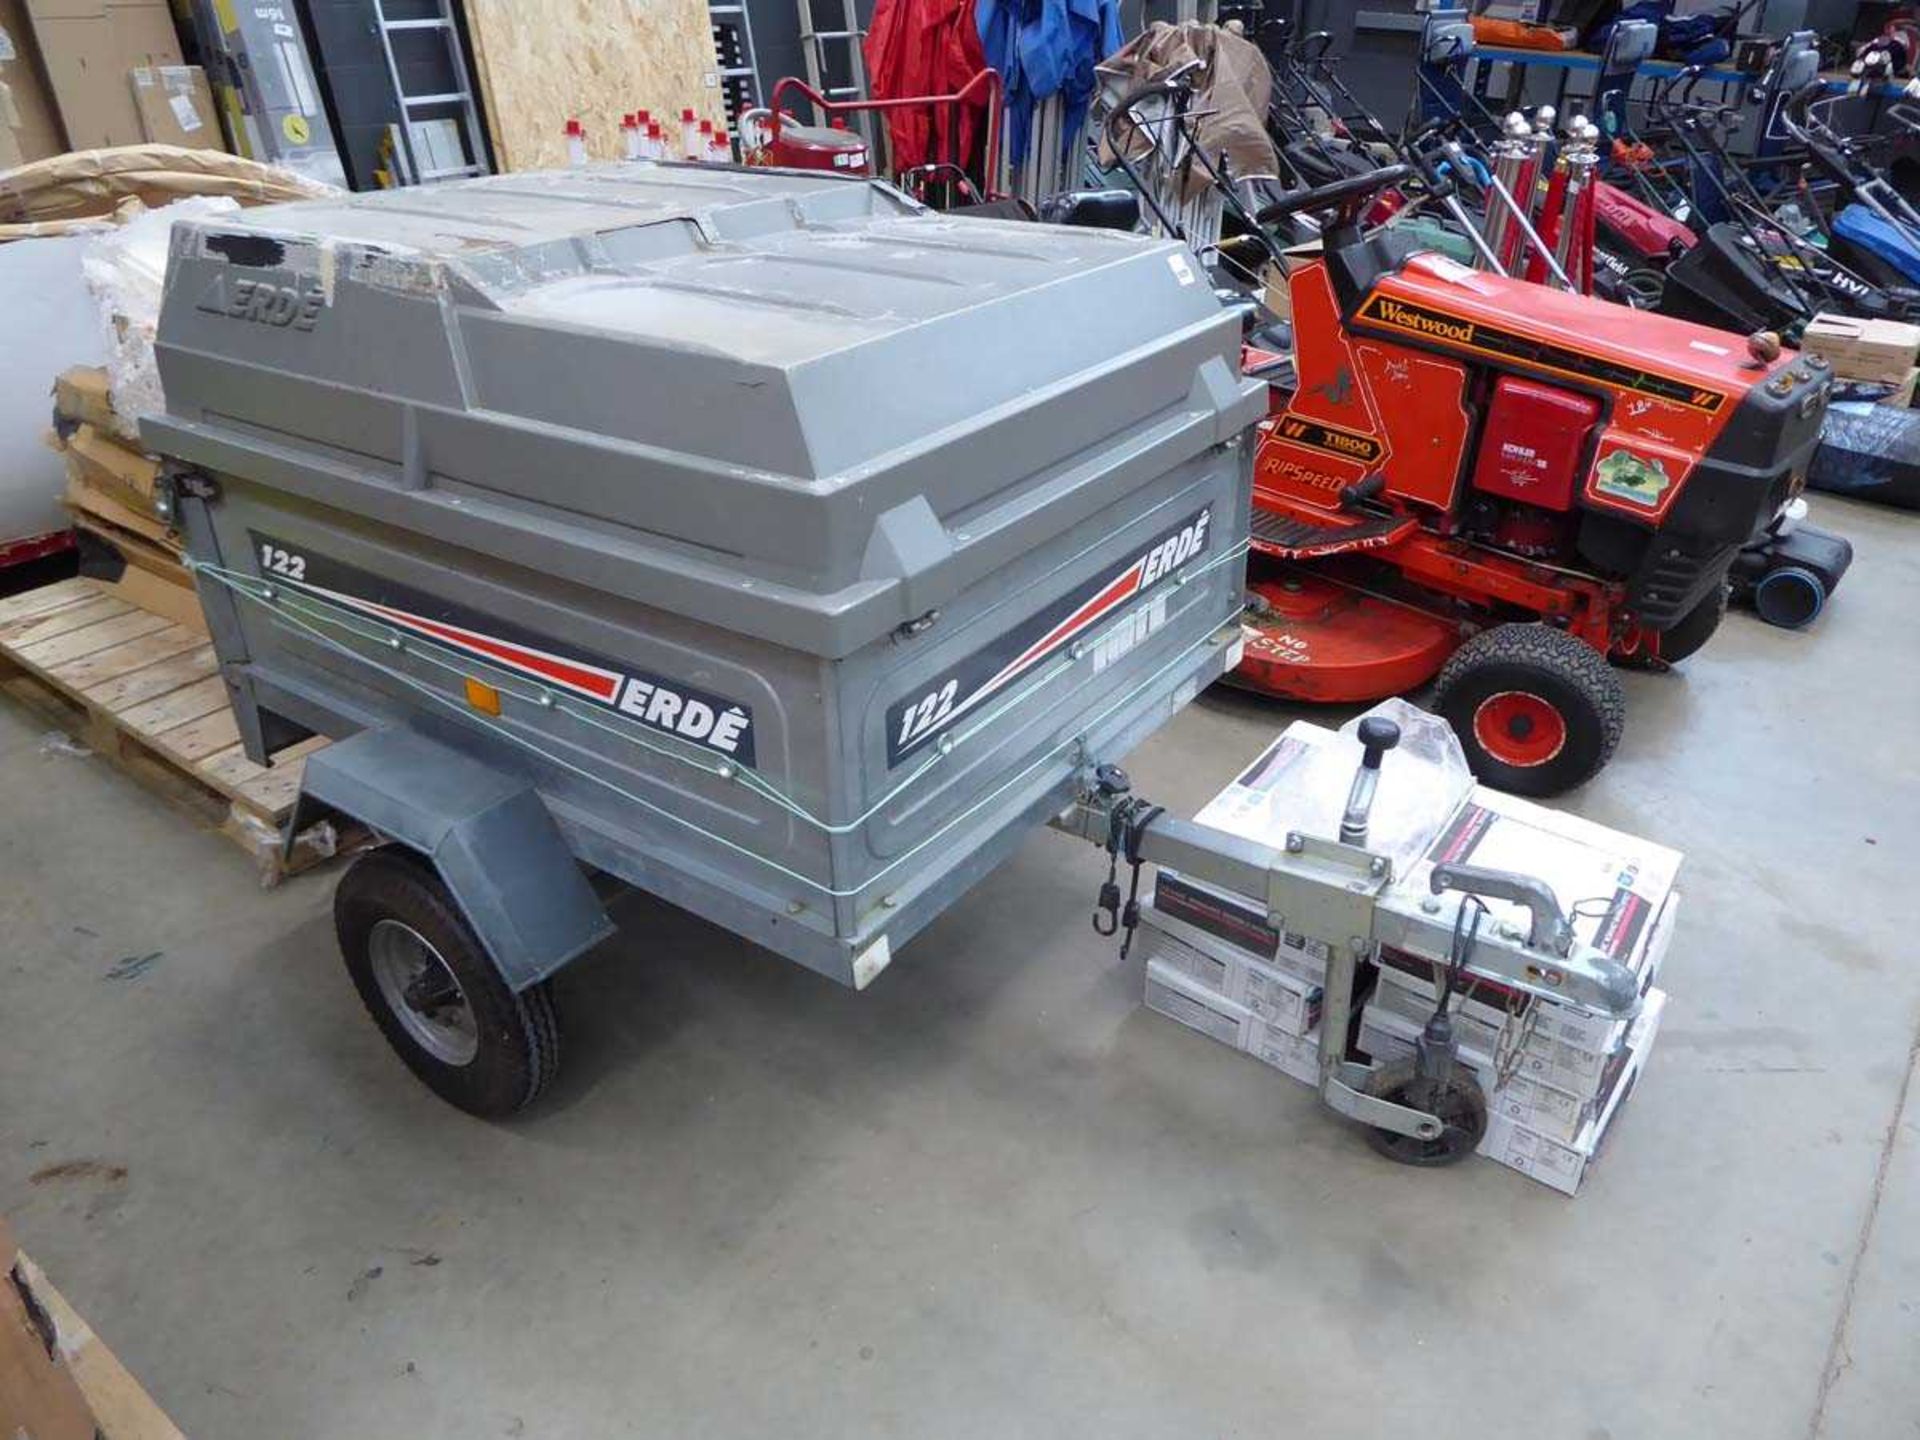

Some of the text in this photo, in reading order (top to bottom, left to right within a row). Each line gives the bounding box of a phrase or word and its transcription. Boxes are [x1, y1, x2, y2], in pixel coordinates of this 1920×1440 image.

[1380, 301, 1475, 341] Westwood
[262, 544, 306, 580] 122
[1278, 634, 1307, 649] NO
[898, 679, 958, 746] 122
